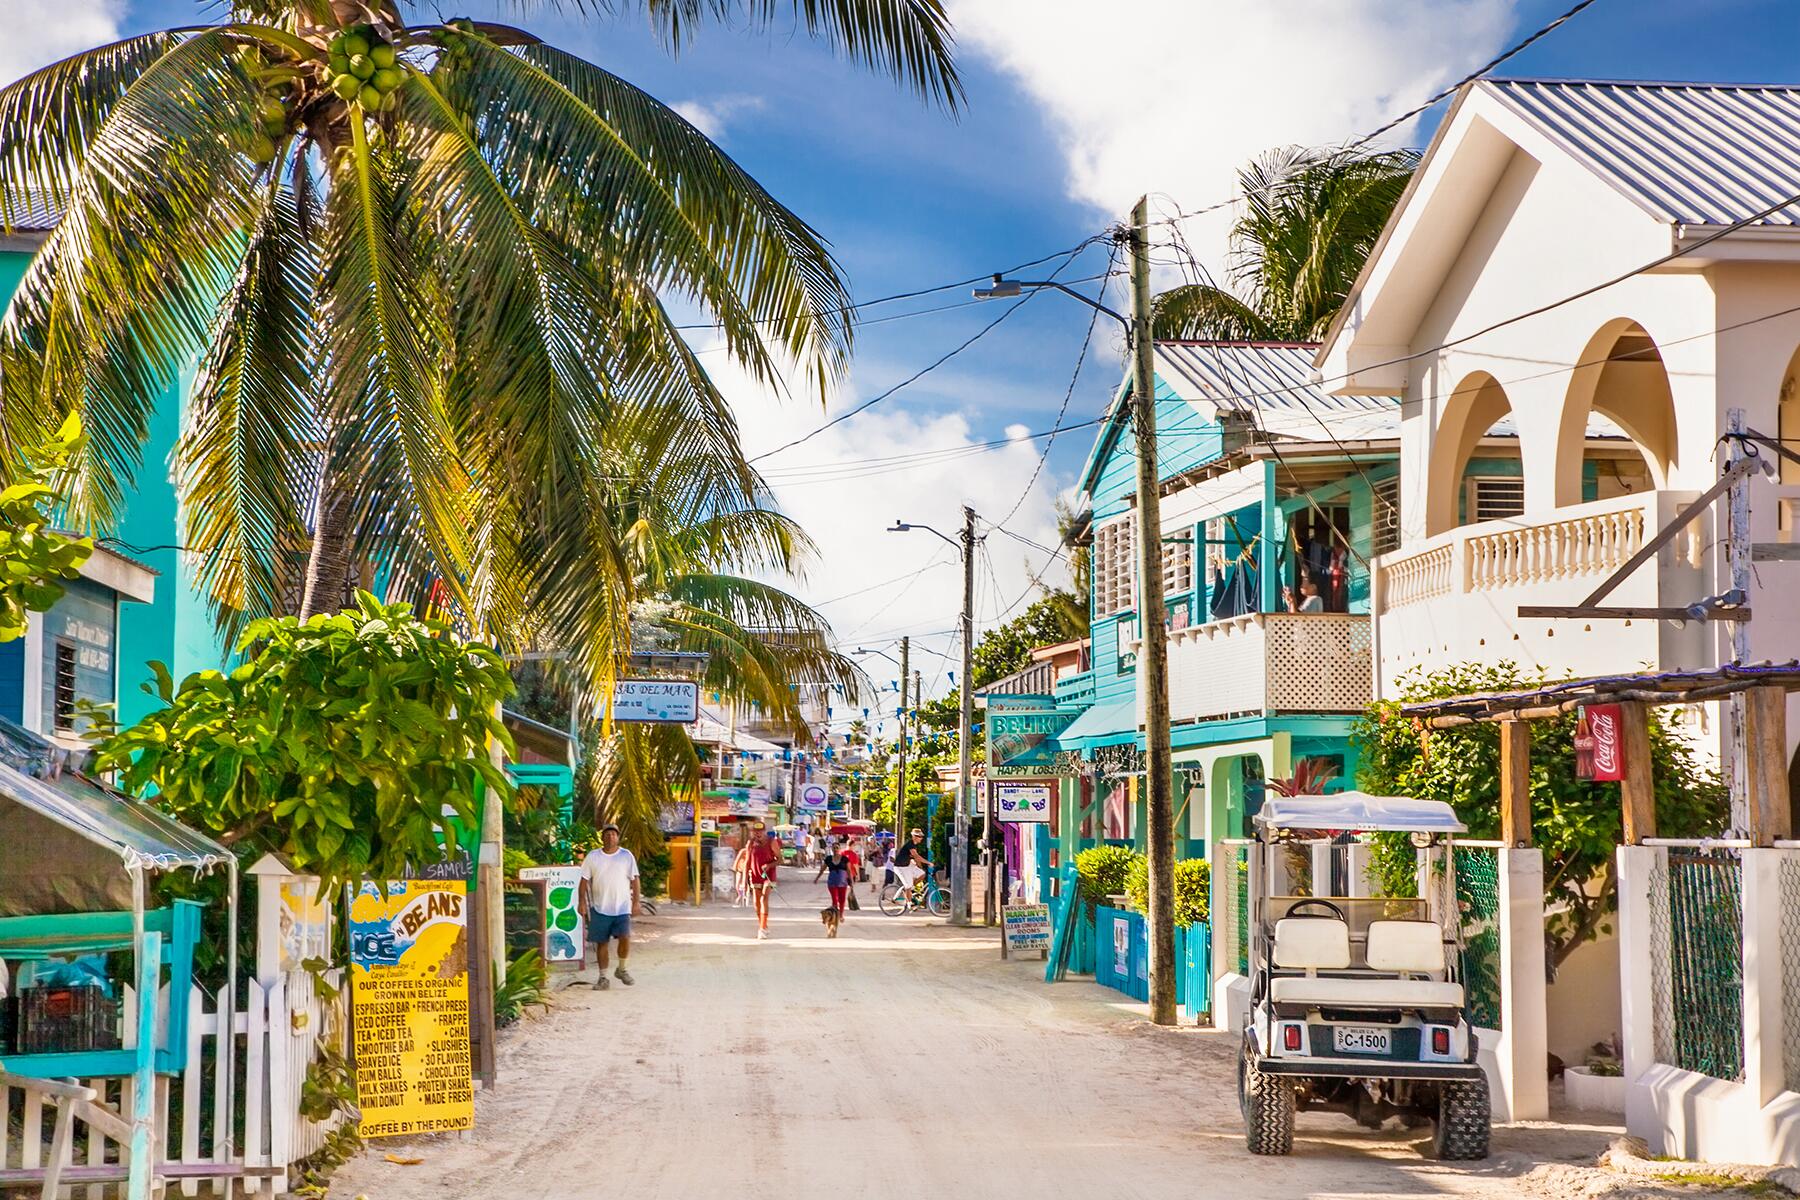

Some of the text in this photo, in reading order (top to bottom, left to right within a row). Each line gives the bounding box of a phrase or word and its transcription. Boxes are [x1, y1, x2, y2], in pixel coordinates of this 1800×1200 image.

[640, 685, 660, 695] DEL
[662, 685, 692, 697] MAR
[997, 766, 1028, 775] HAPPY
[427, 861, 474, 878] SAMPLE
[401, 892, 462, 937] BEANS
[353, 932, 398, 961] ICE
[359, 979, 463, 990] OUR COFFEE IS ORGANIC
[374, 989, 447, 1000] GROWN IN BELIZE
[355, 1001, 410, 1015] ESPRESSO BAR
[417, 1000, 467, 1012] FRENCH PRESS
[356, 1015, 406, 1029] ICED COFFEE
[439, 1013, 467, 1026] FRAPPE
[356, 1027, 412, 1041] TEA ICED TEA
[450, 1026, 467, 1038] CHAI
[356, 1040, 414, 1056] SMOOTHIE BAR
[432, 1039, 468, 1052] SLUSHIES
[1345, 1034, 1386, 1048] C-1500
[357, 1054, 401, 1069] SHAVED ICE
[426, 1052, 469, 1066] 30 FLAVORS
[359, 1068, 402, 1083] RUM BALLS
[425, 1065, 470, 1079] CHOCOLATES
[360, 1080, 408, 1095] MILK SHAKES
[417, 1078, 470, 1092] PROTEIN SHAKE
[360, 1094, 404, 1109] MINI DONUT
[424, 1090, 472, 1105] MADE FRESH
[361, 1117, 472, 1136] COFFEE BY THE POUND!
